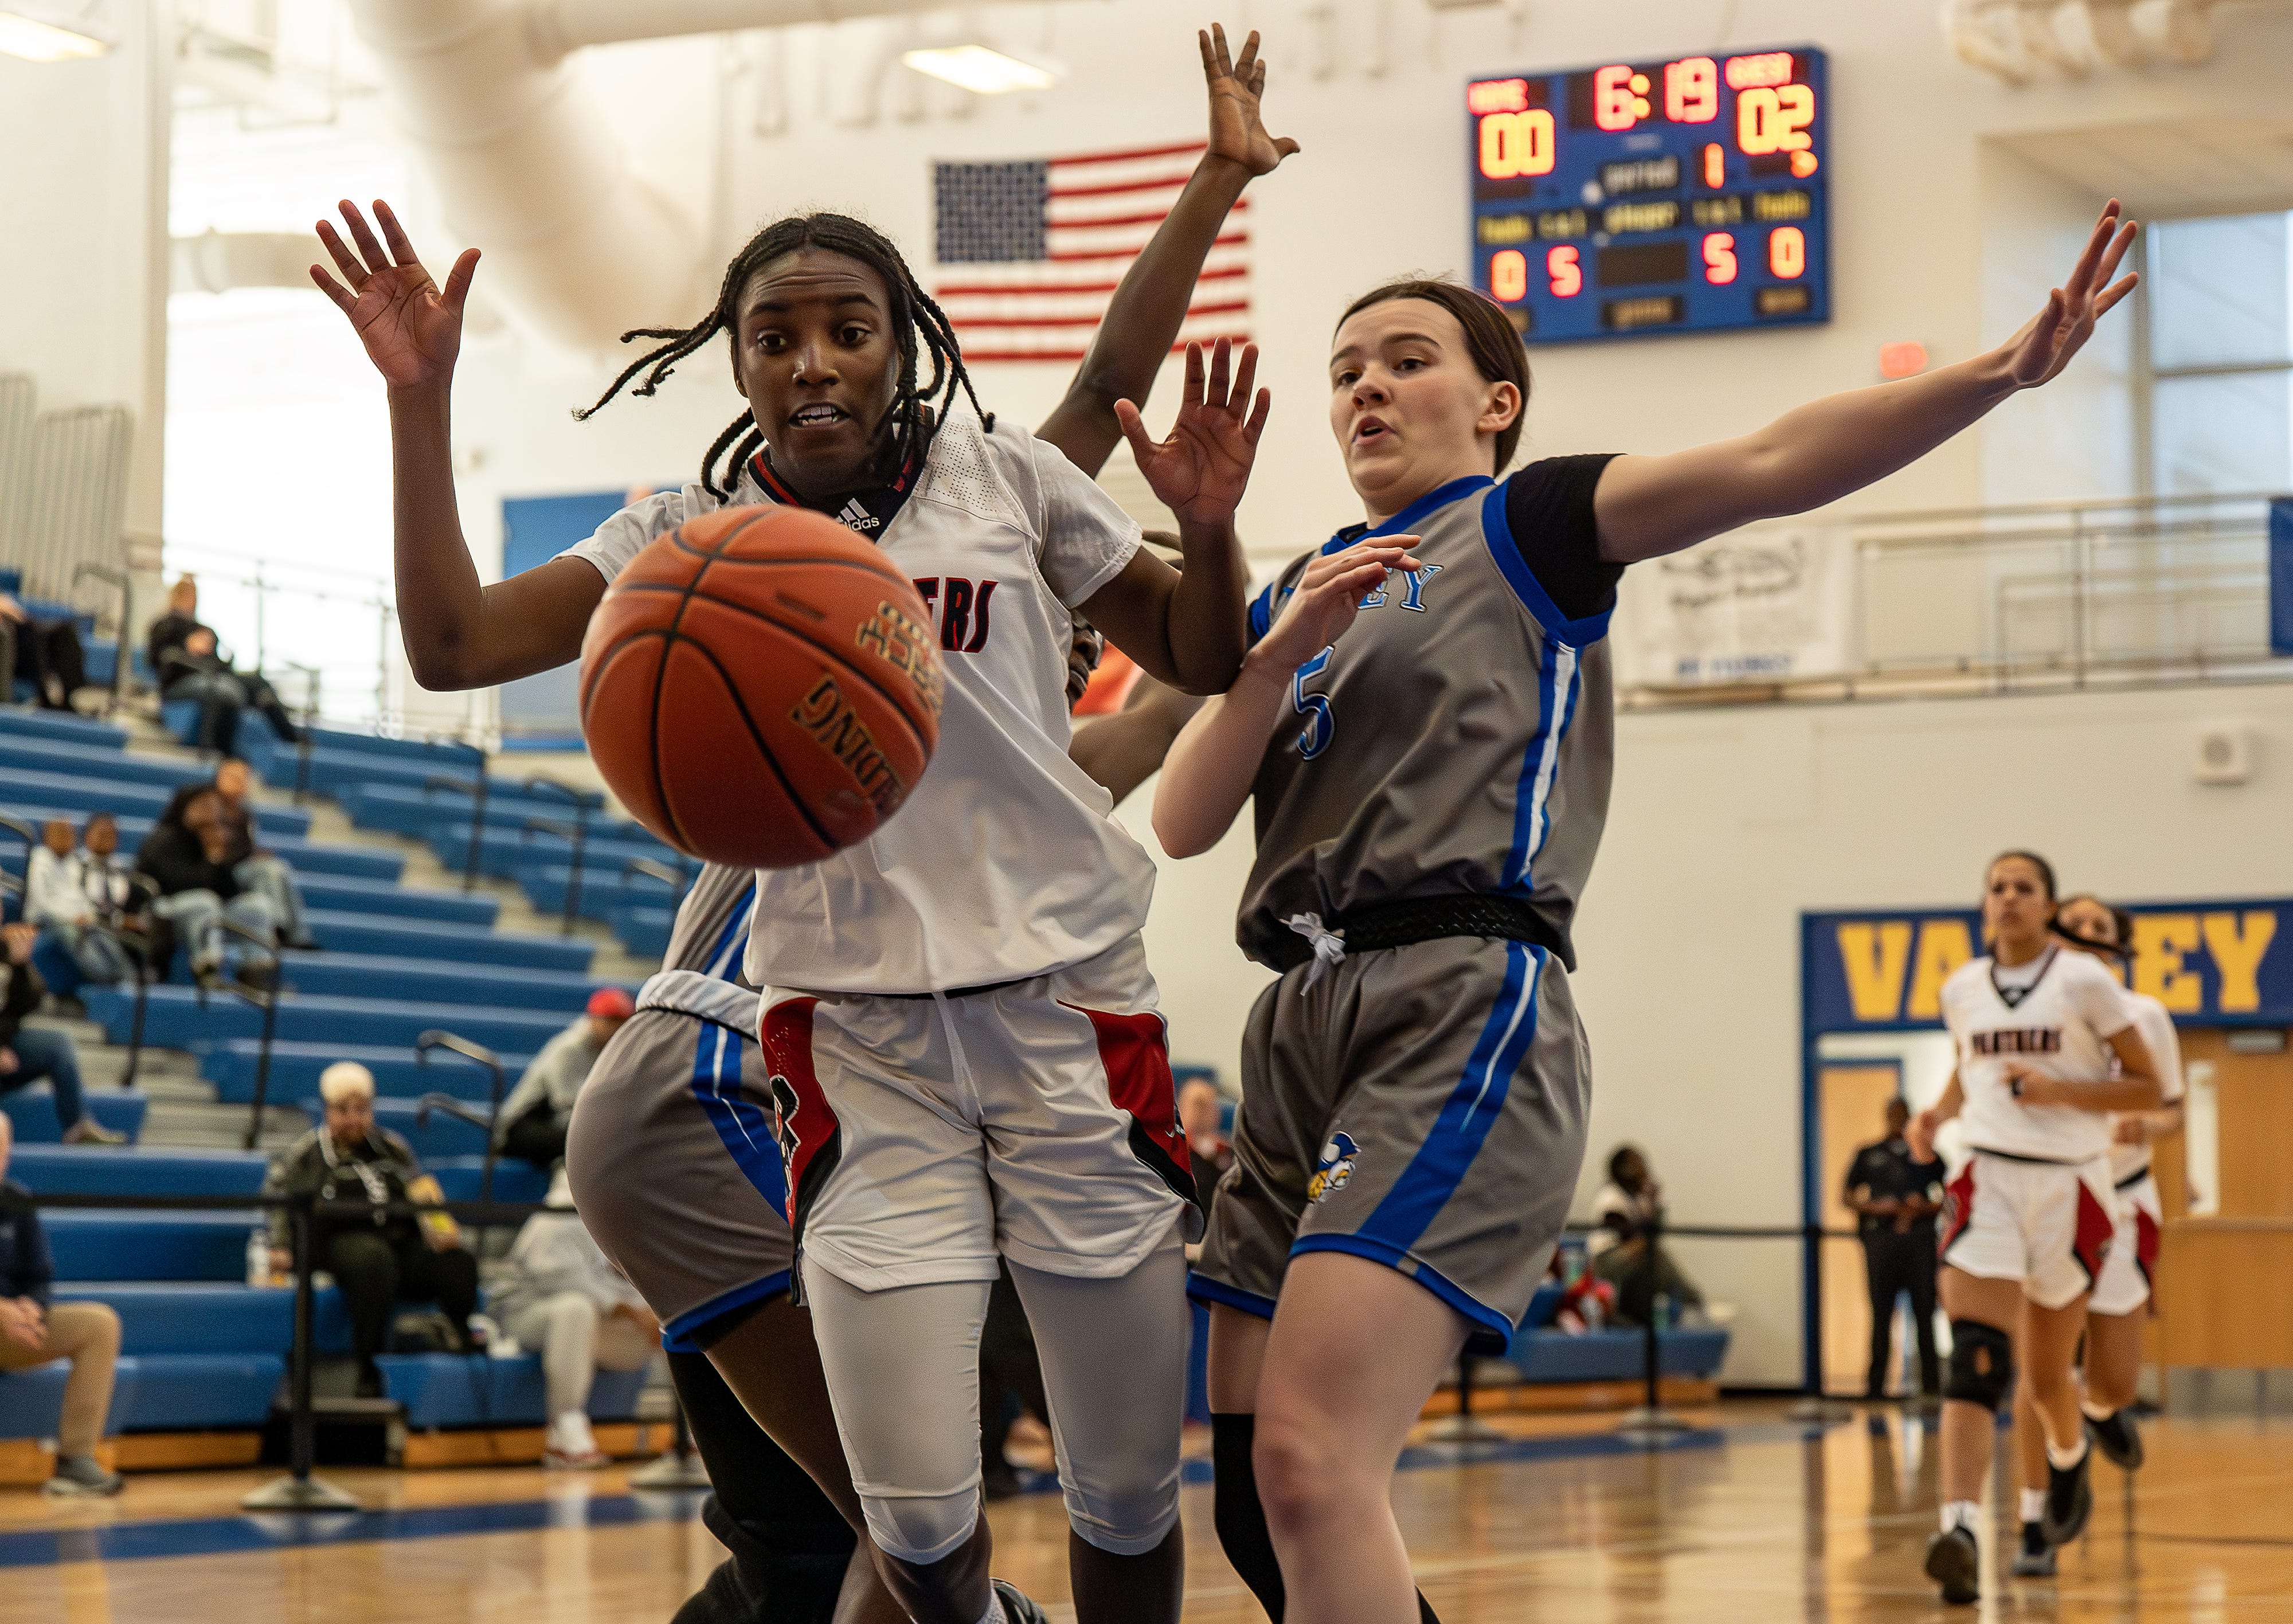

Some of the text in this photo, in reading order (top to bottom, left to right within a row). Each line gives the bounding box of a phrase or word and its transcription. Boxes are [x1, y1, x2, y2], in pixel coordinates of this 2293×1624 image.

[1594, 56, 1719, 132] 6:19
[1737, 84, 1815, 156] 02
[1479, 108, 1555, 179] 00
[1705, 143, 1725, 189] 1
[1491, 245, 1582, 302] 0 5
[1701, 226, 1805, 285] 5 0
[1292, 645, 1335, 761] 5
[1838, 910, 2277, 1022] VAEY
